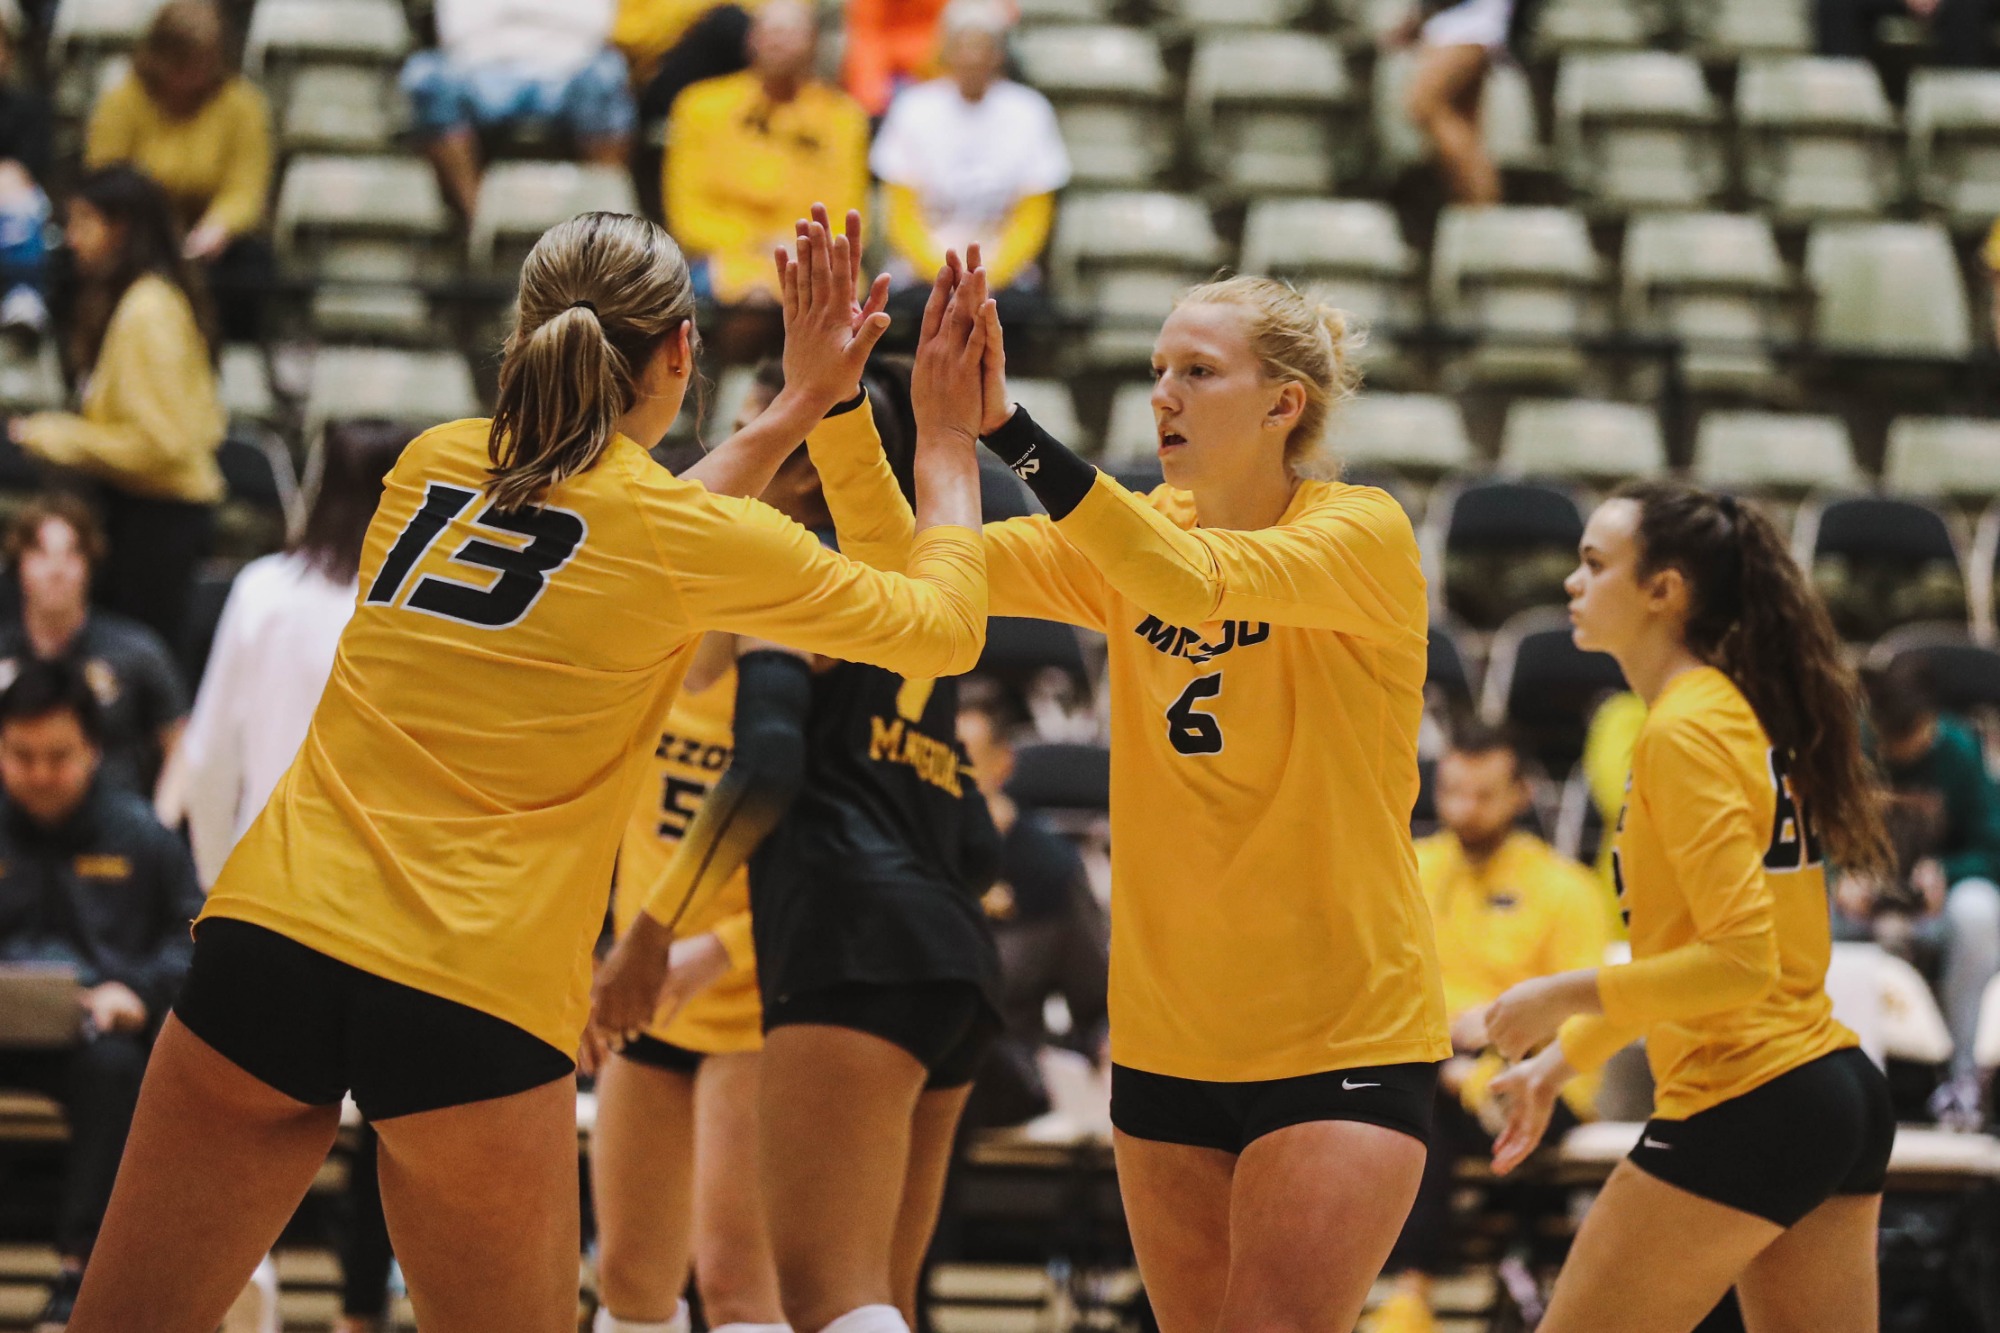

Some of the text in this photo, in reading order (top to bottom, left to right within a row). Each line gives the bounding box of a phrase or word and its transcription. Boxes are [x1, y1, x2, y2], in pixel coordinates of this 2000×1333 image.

[363, 479, 589, 631] 13
[1166, 669, 1224, 756] 6
[657, 772, 709, 842] 5
